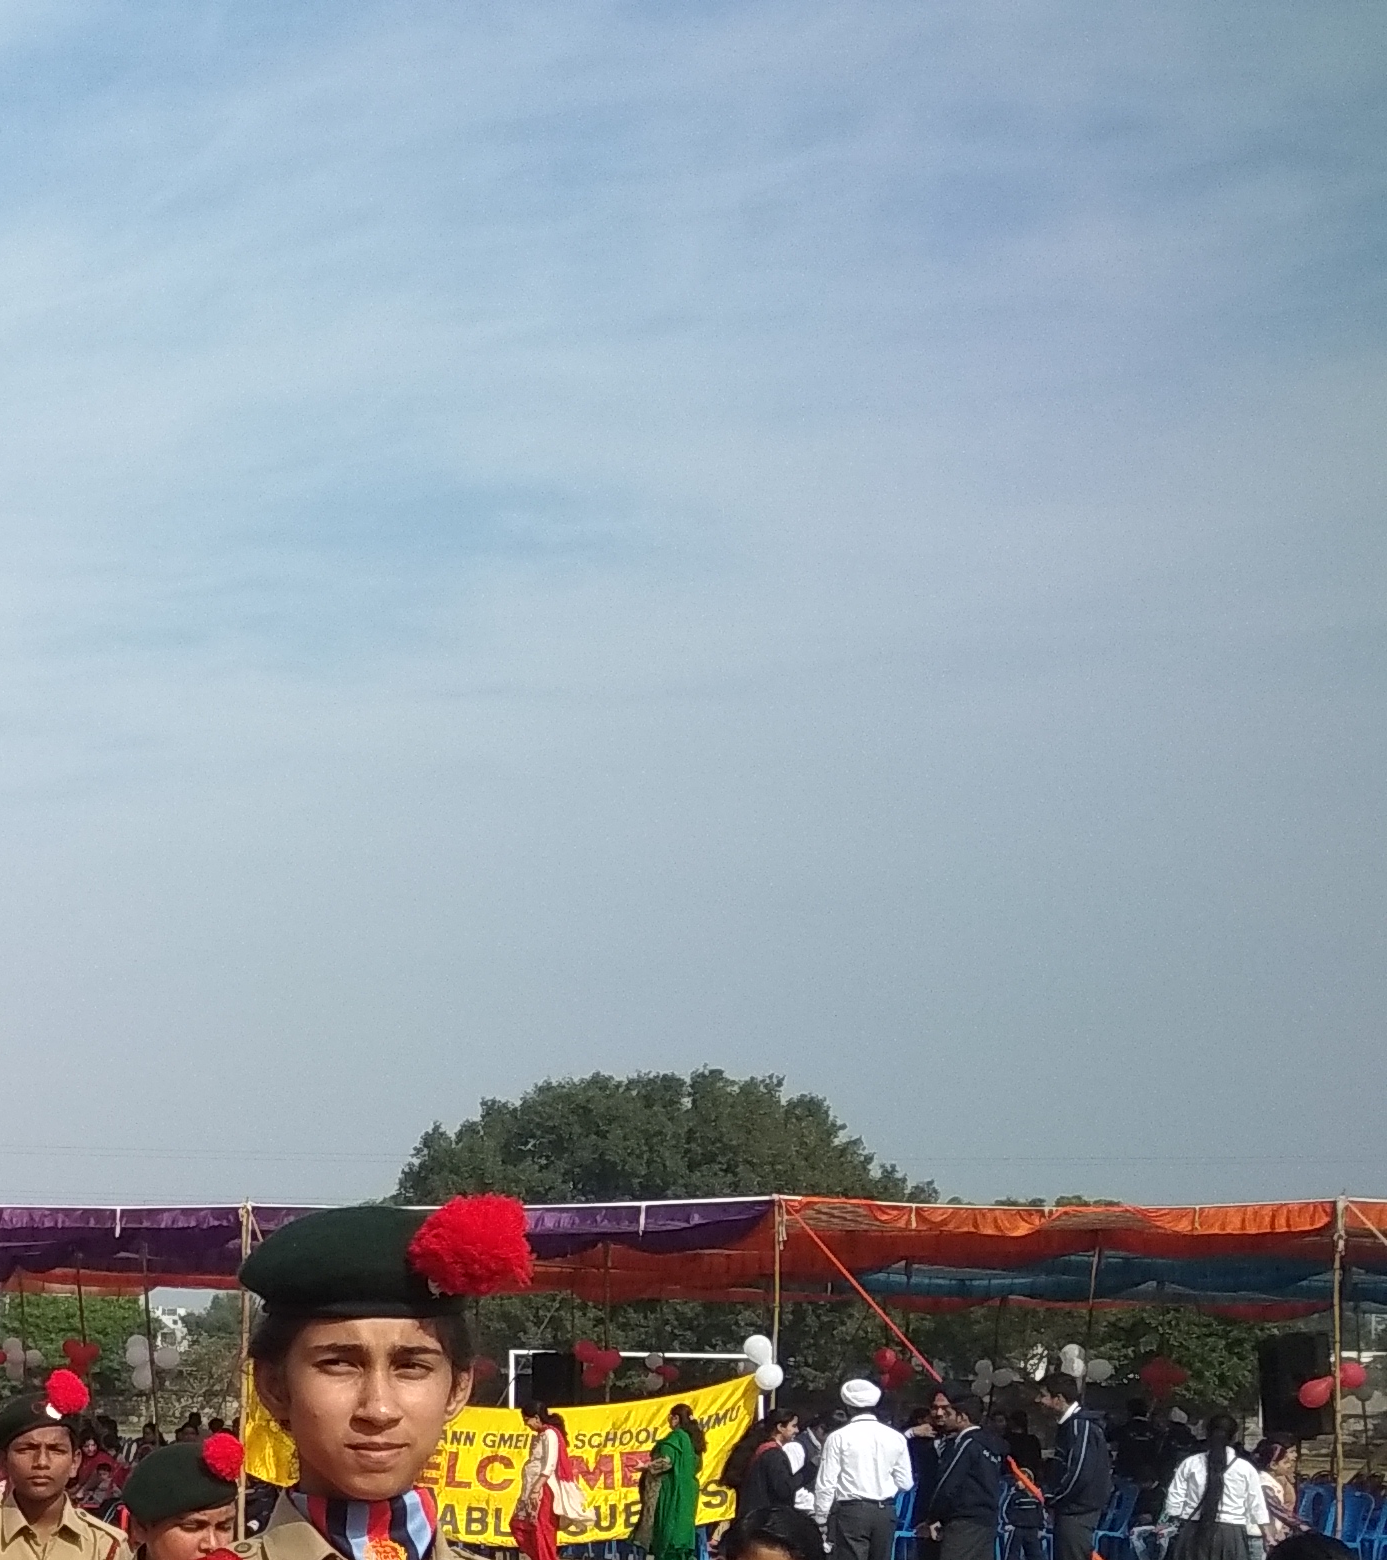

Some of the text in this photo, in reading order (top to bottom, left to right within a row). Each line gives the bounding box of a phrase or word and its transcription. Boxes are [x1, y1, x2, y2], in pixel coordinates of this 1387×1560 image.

[482, 1433, 530, 1449] GMEI
[573, 1426, 659, 1450] SCHOOL
[698, 1404, 741, 1430] MMU
